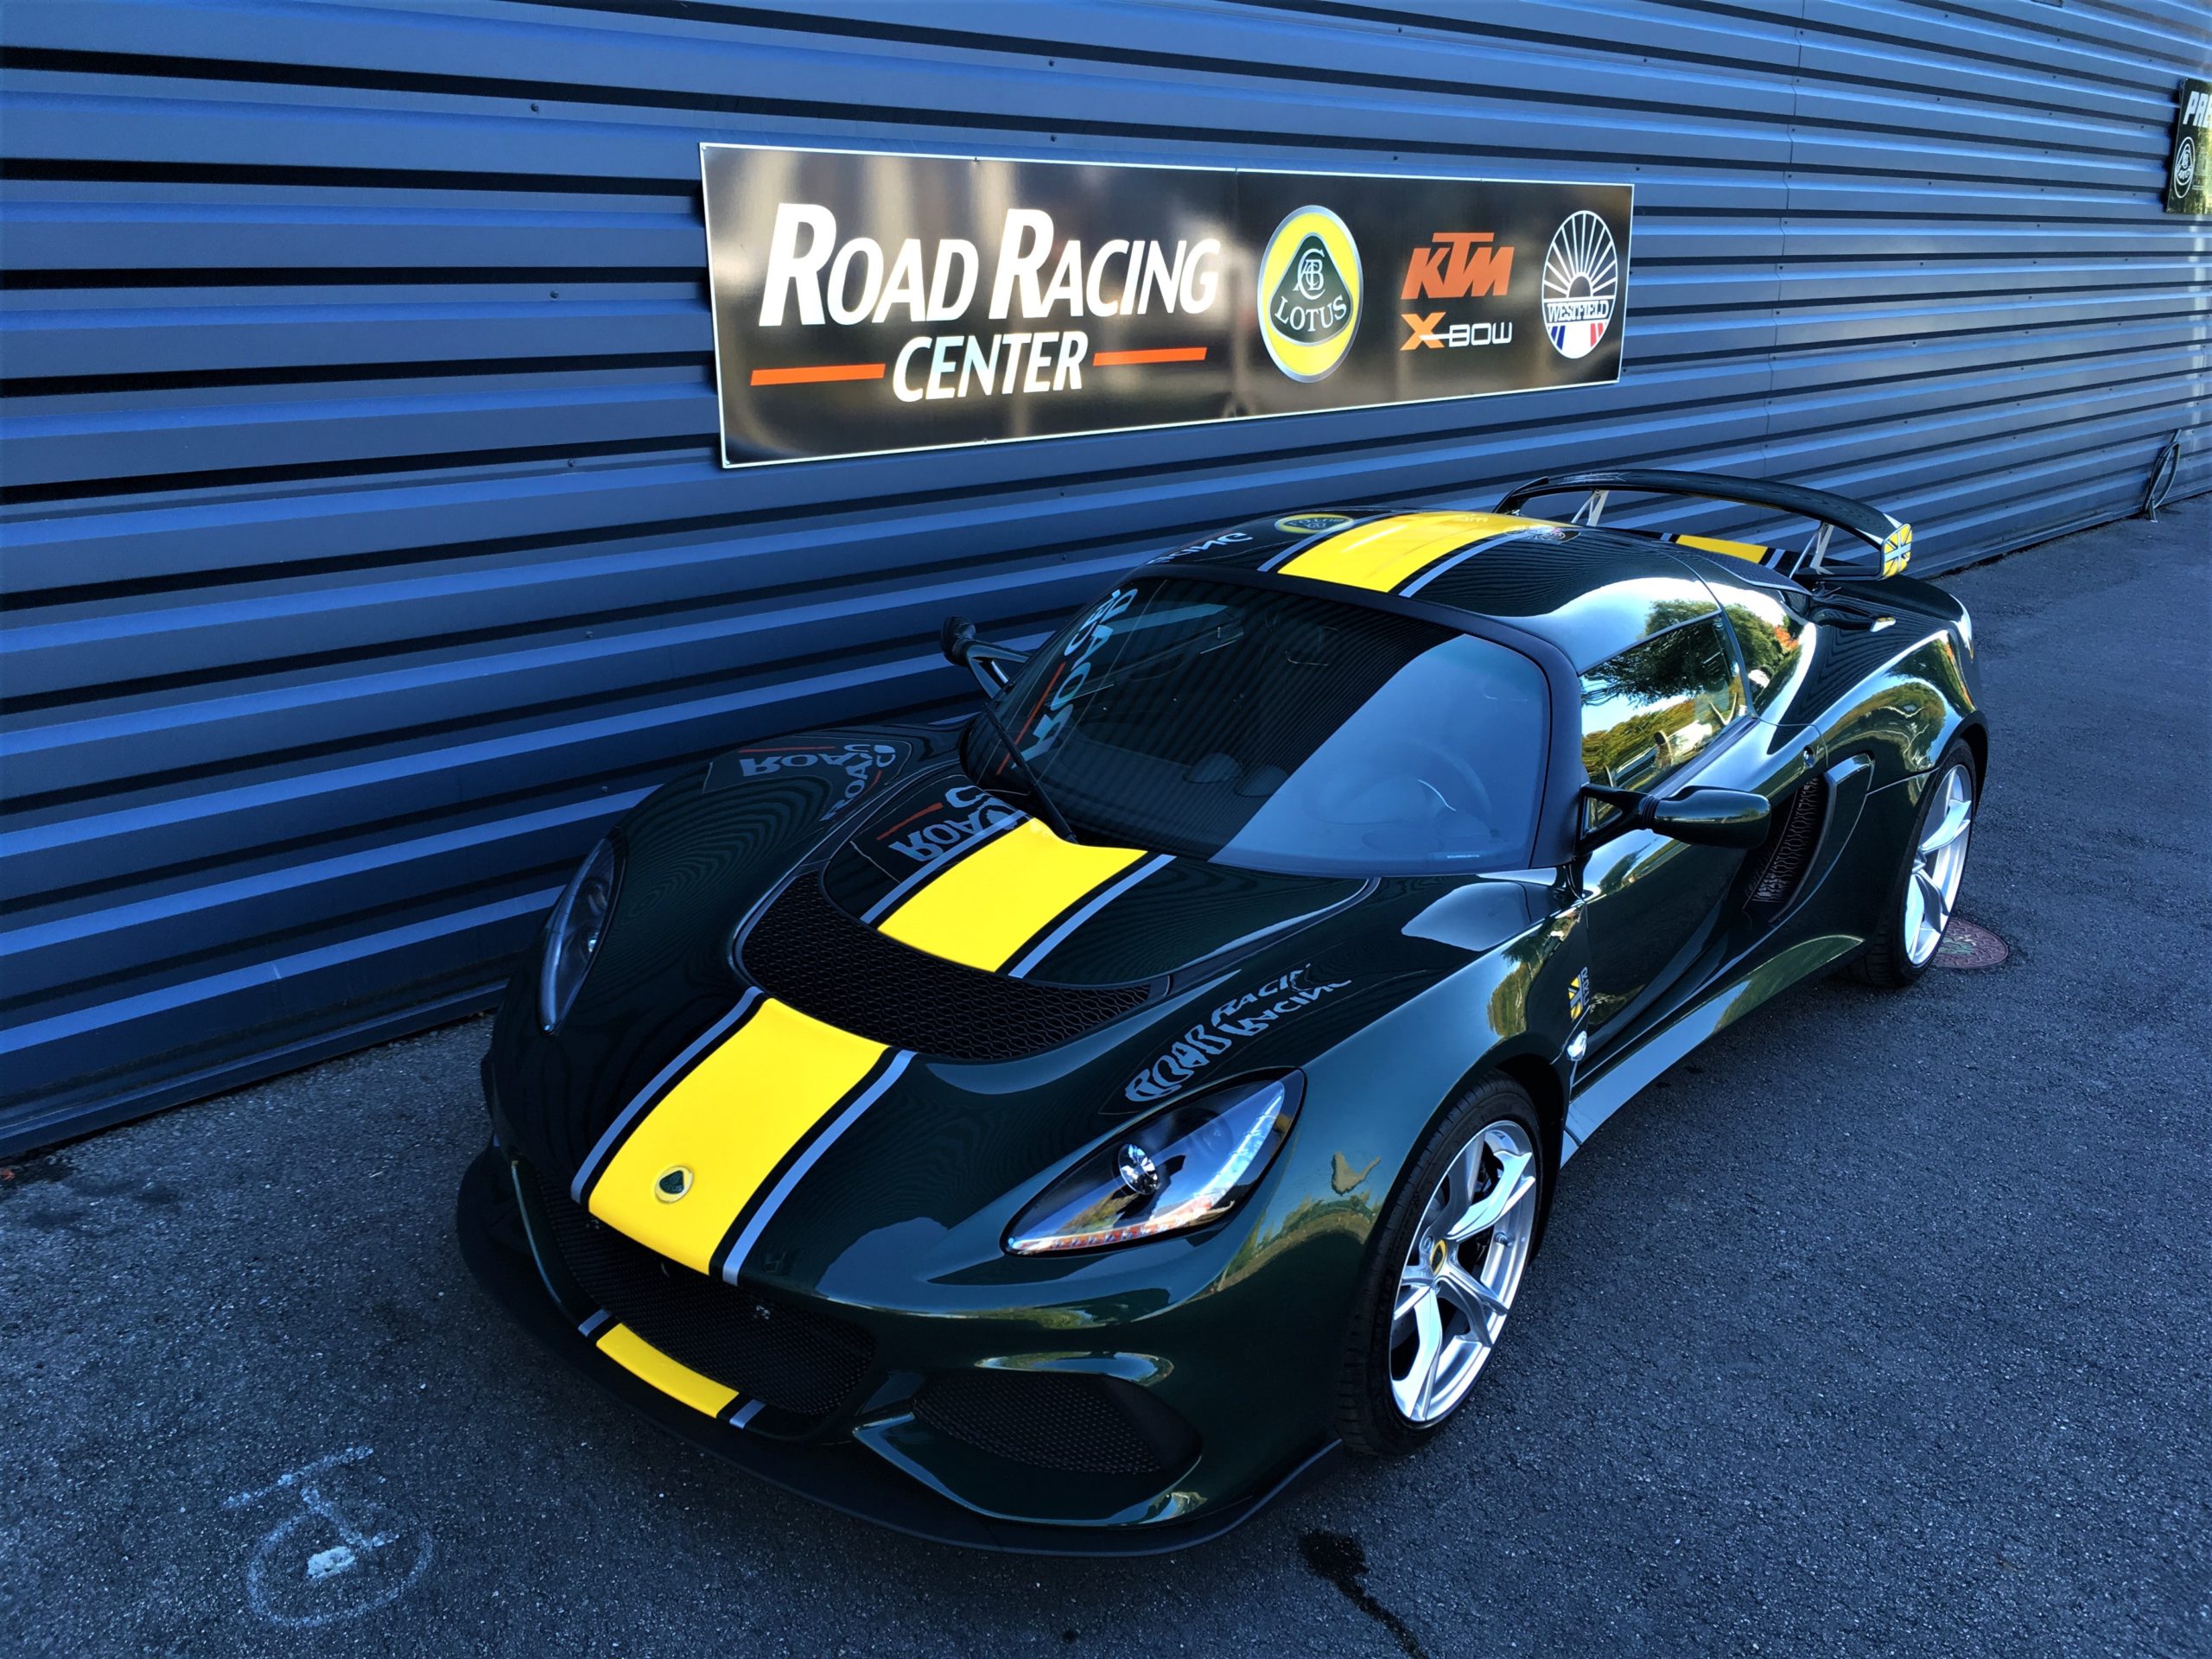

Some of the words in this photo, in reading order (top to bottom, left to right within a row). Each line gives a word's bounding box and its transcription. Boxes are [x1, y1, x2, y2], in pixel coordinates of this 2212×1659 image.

[760, 203, 979, 326] ROAD
[988, 208, 1221, 320] RACING
[1401, 232, 1515, 300] KTM
[1274, 295, 1347, 332] LOTUS
[1547, 301, 1610, 322] WESTFIELD
[893, 331, 1089, 403] CENTER
